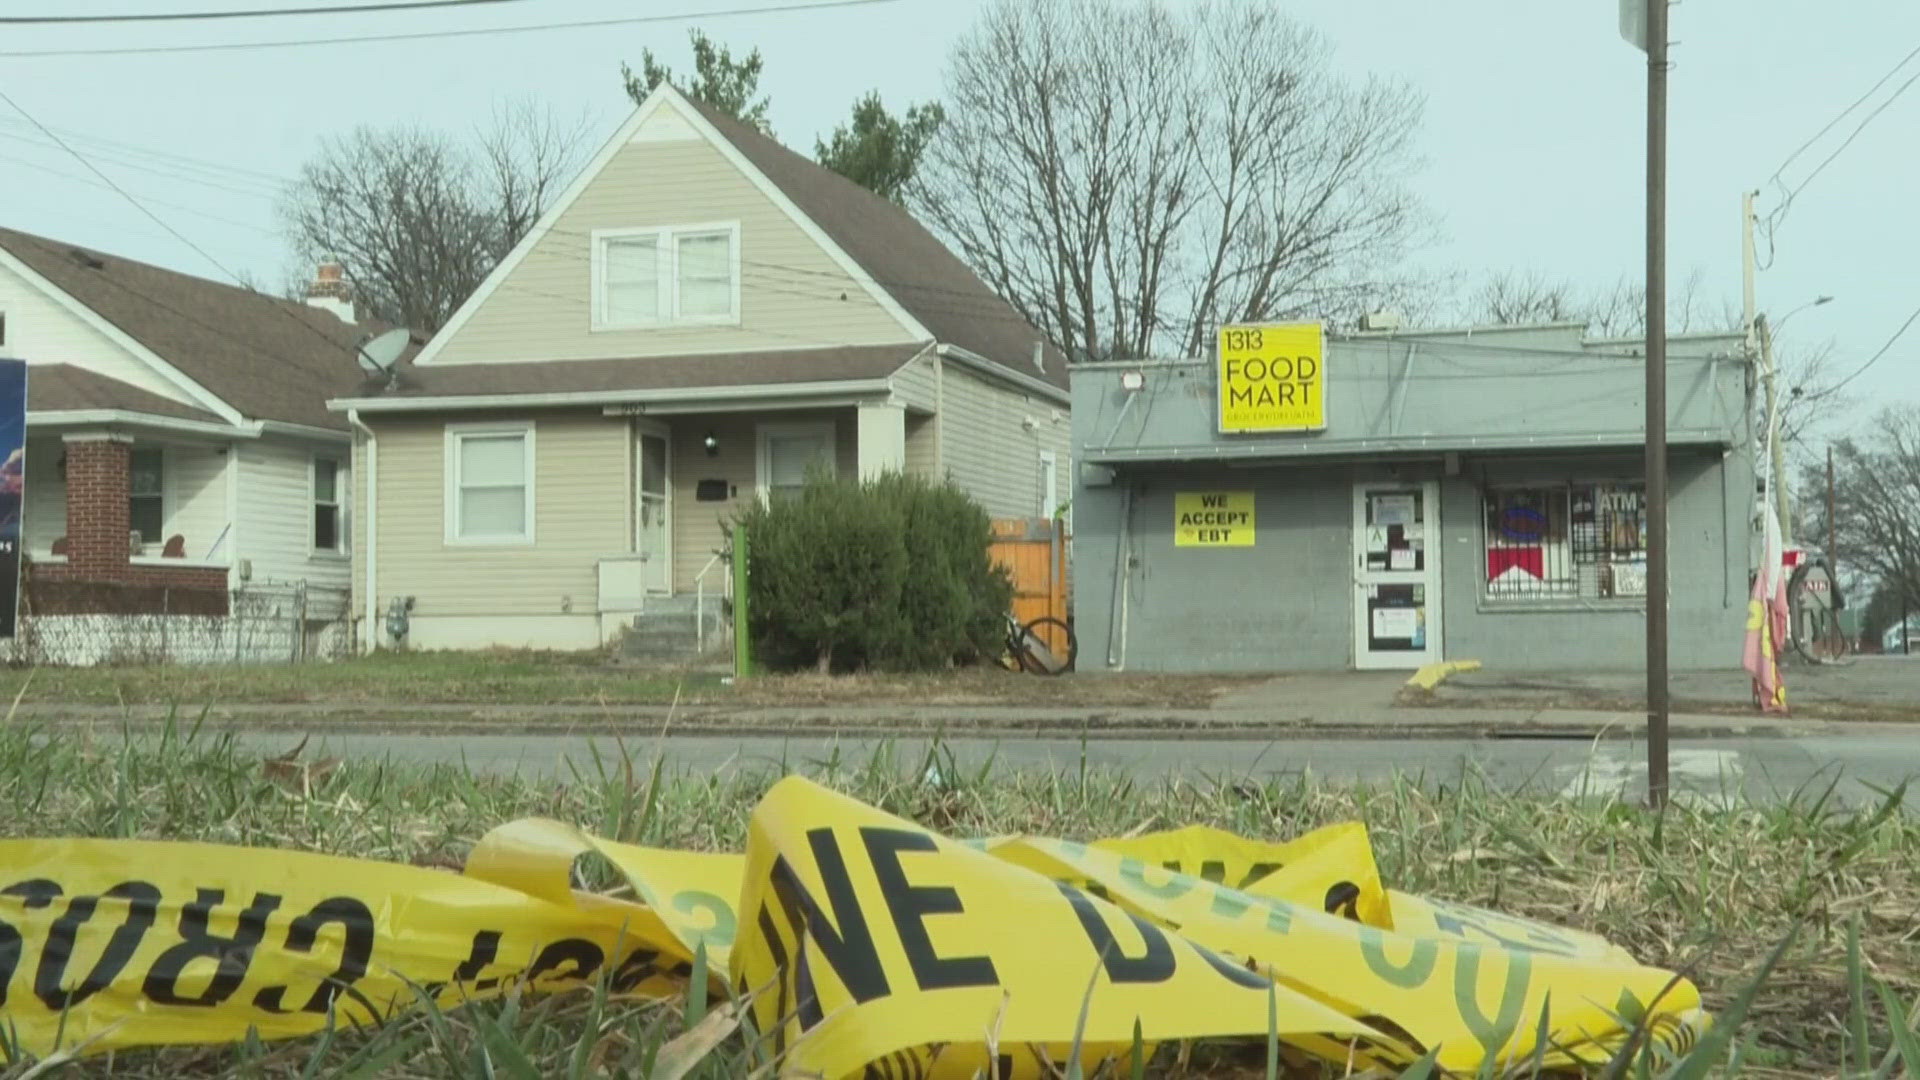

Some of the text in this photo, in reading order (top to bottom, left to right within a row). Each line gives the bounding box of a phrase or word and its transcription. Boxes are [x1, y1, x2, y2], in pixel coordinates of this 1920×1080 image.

[1225, 329, 1263, 351] 1313
[1226, 356, 1317, 383] FOOD
[1229, 381, 1314, 408] MART
[1202, 495, 1229, 508] WE
[1600, 492, 1637, 512] ATM
[1180, 512, 1249, 526] ACCEPT
[1198, 530, 1231, 542] EBT
[1805, 580, 1826, 592] AIR
